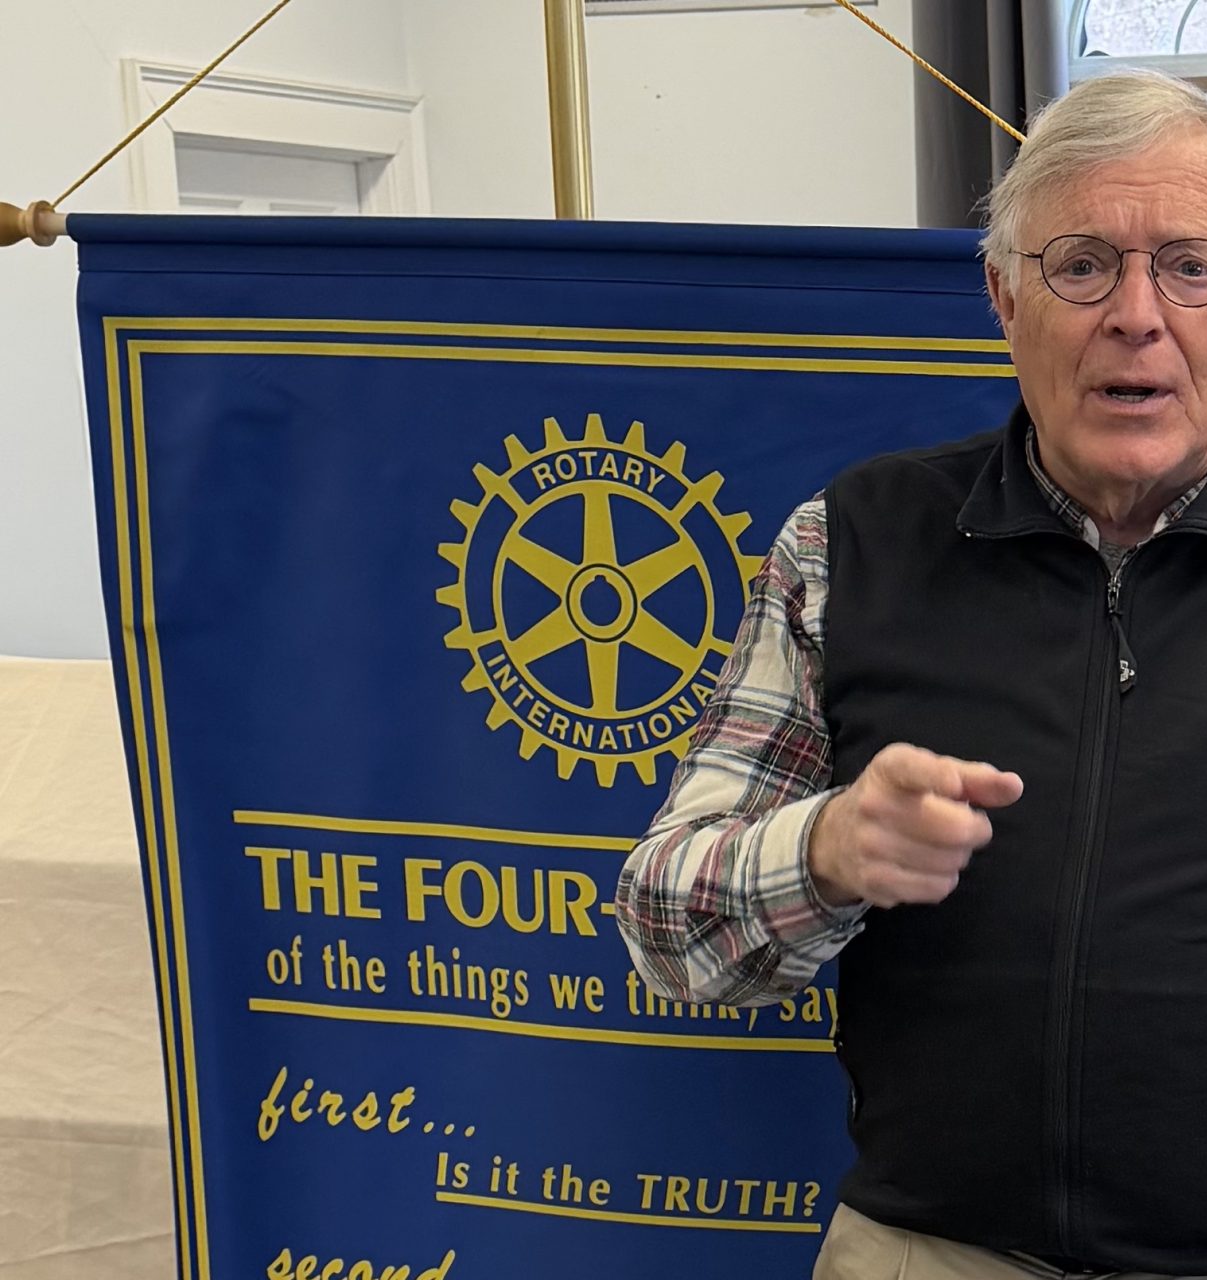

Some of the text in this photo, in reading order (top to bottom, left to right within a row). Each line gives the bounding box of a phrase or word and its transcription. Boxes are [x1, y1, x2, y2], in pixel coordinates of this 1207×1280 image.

[531, 450, 666, 494] ROTARY
[244, 847, 381, 919] THE
[267, 938, 301, 985] of
[322, 940, 385, 994] the
[407, 945, 529, 1019] things
[549, 975, 604, 1013] we
[436, 1152, 821, 1217] Is it the TRUTH?
